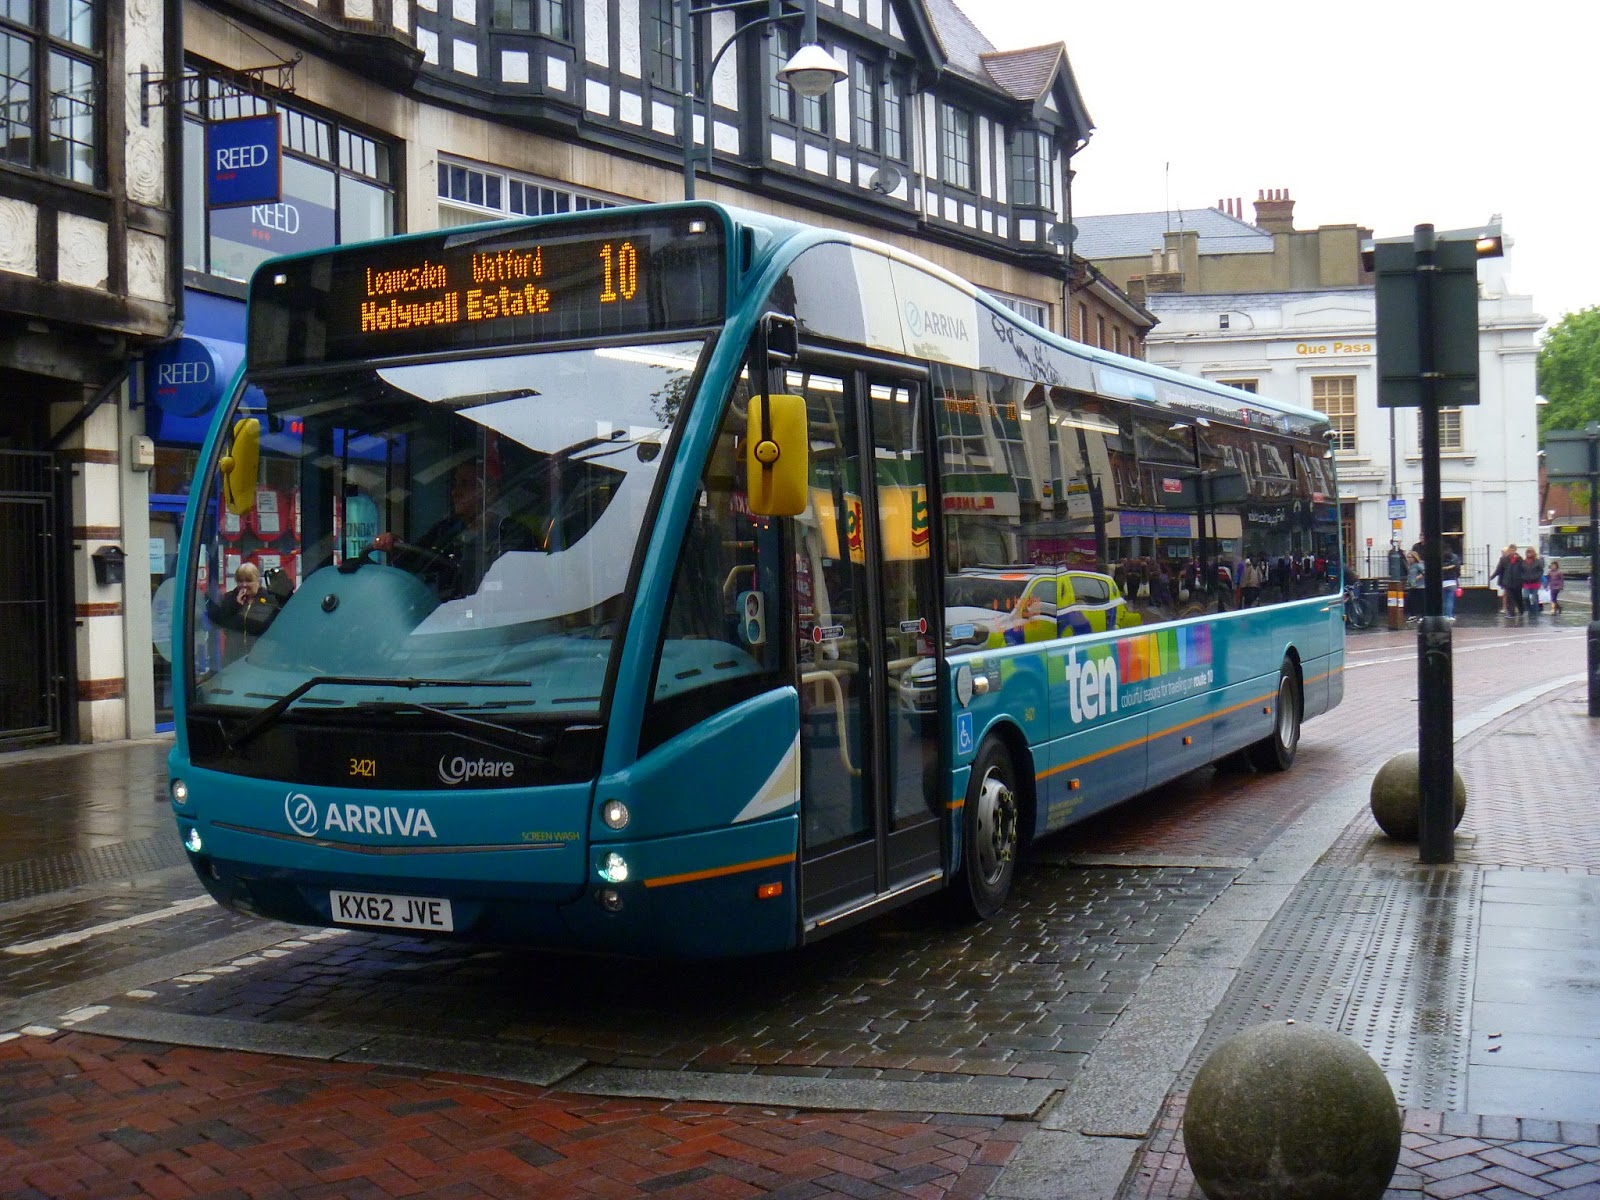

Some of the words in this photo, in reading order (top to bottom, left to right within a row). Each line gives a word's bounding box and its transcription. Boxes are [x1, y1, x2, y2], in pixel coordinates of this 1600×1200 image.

[216, 144, 269, 171] REED
[251, 202, 300, 235] REED
[366, 260, 447, 296] Leavesden
[472, 245, 543, 283] Watford
[600, 242, 636, 303] 10
[361, 291, 458, 332] Holywell
[466, 283, 550, 321] Estate
[924, 310, 969, 342] ARRIVA
[1296, 343, 1327, 355] Que
[1333, 342, 1372, 353] Pasa
[158, 361, 210, 385] REED
[1066, 645, 1118, 724] ten
[1193, 672, 1206, 688] route
[1207, 669, 1213, 683] 10
[350, 758, 376, 777] 3421
[450, 756, 515, 782] Optare
[324, 803, 437, 838] ARRIVA
[521, 831, 553, 841] SCREEN
[553, 831, 580, 841] WASH
[338, 895, 395, 922] KX62
[401, 900, 444, 926] JVE
